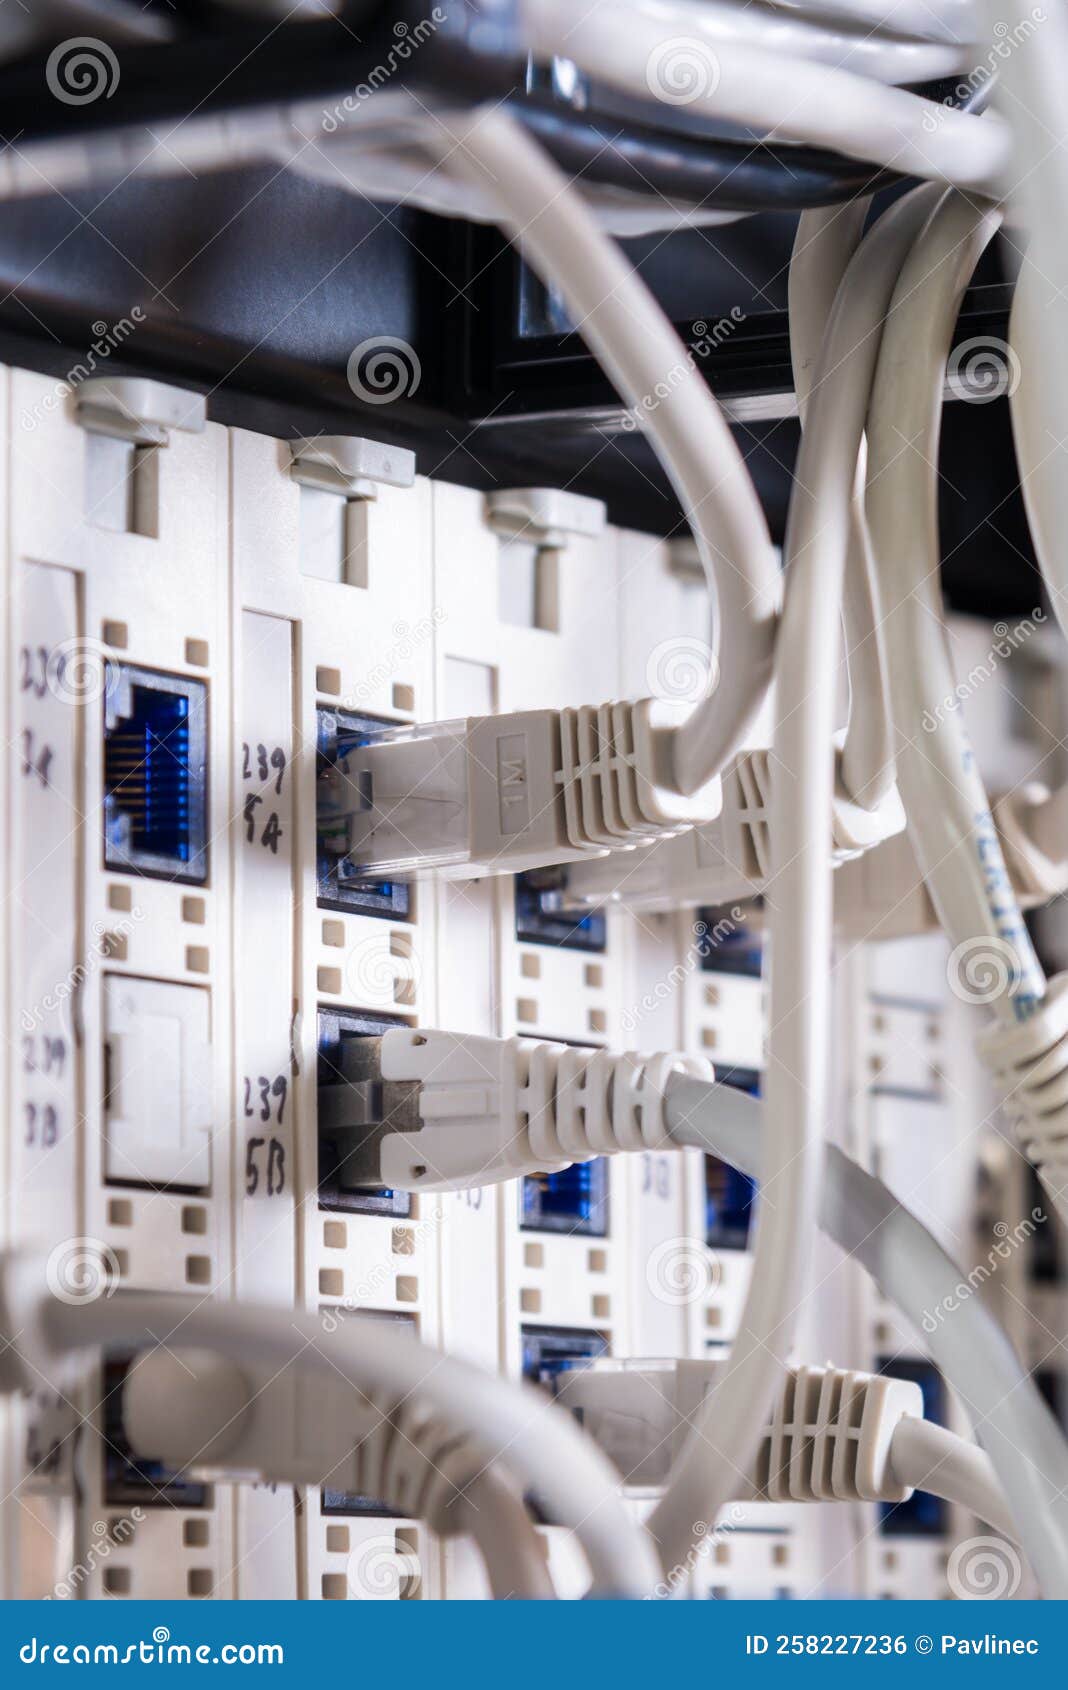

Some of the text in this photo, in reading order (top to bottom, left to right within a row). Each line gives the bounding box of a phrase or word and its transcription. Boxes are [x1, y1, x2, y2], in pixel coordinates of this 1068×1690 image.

[242, 741, 286, 795] 239
[244, 1074, 288, 1125] 239
[245, 1137, 285, 1197] 5B
